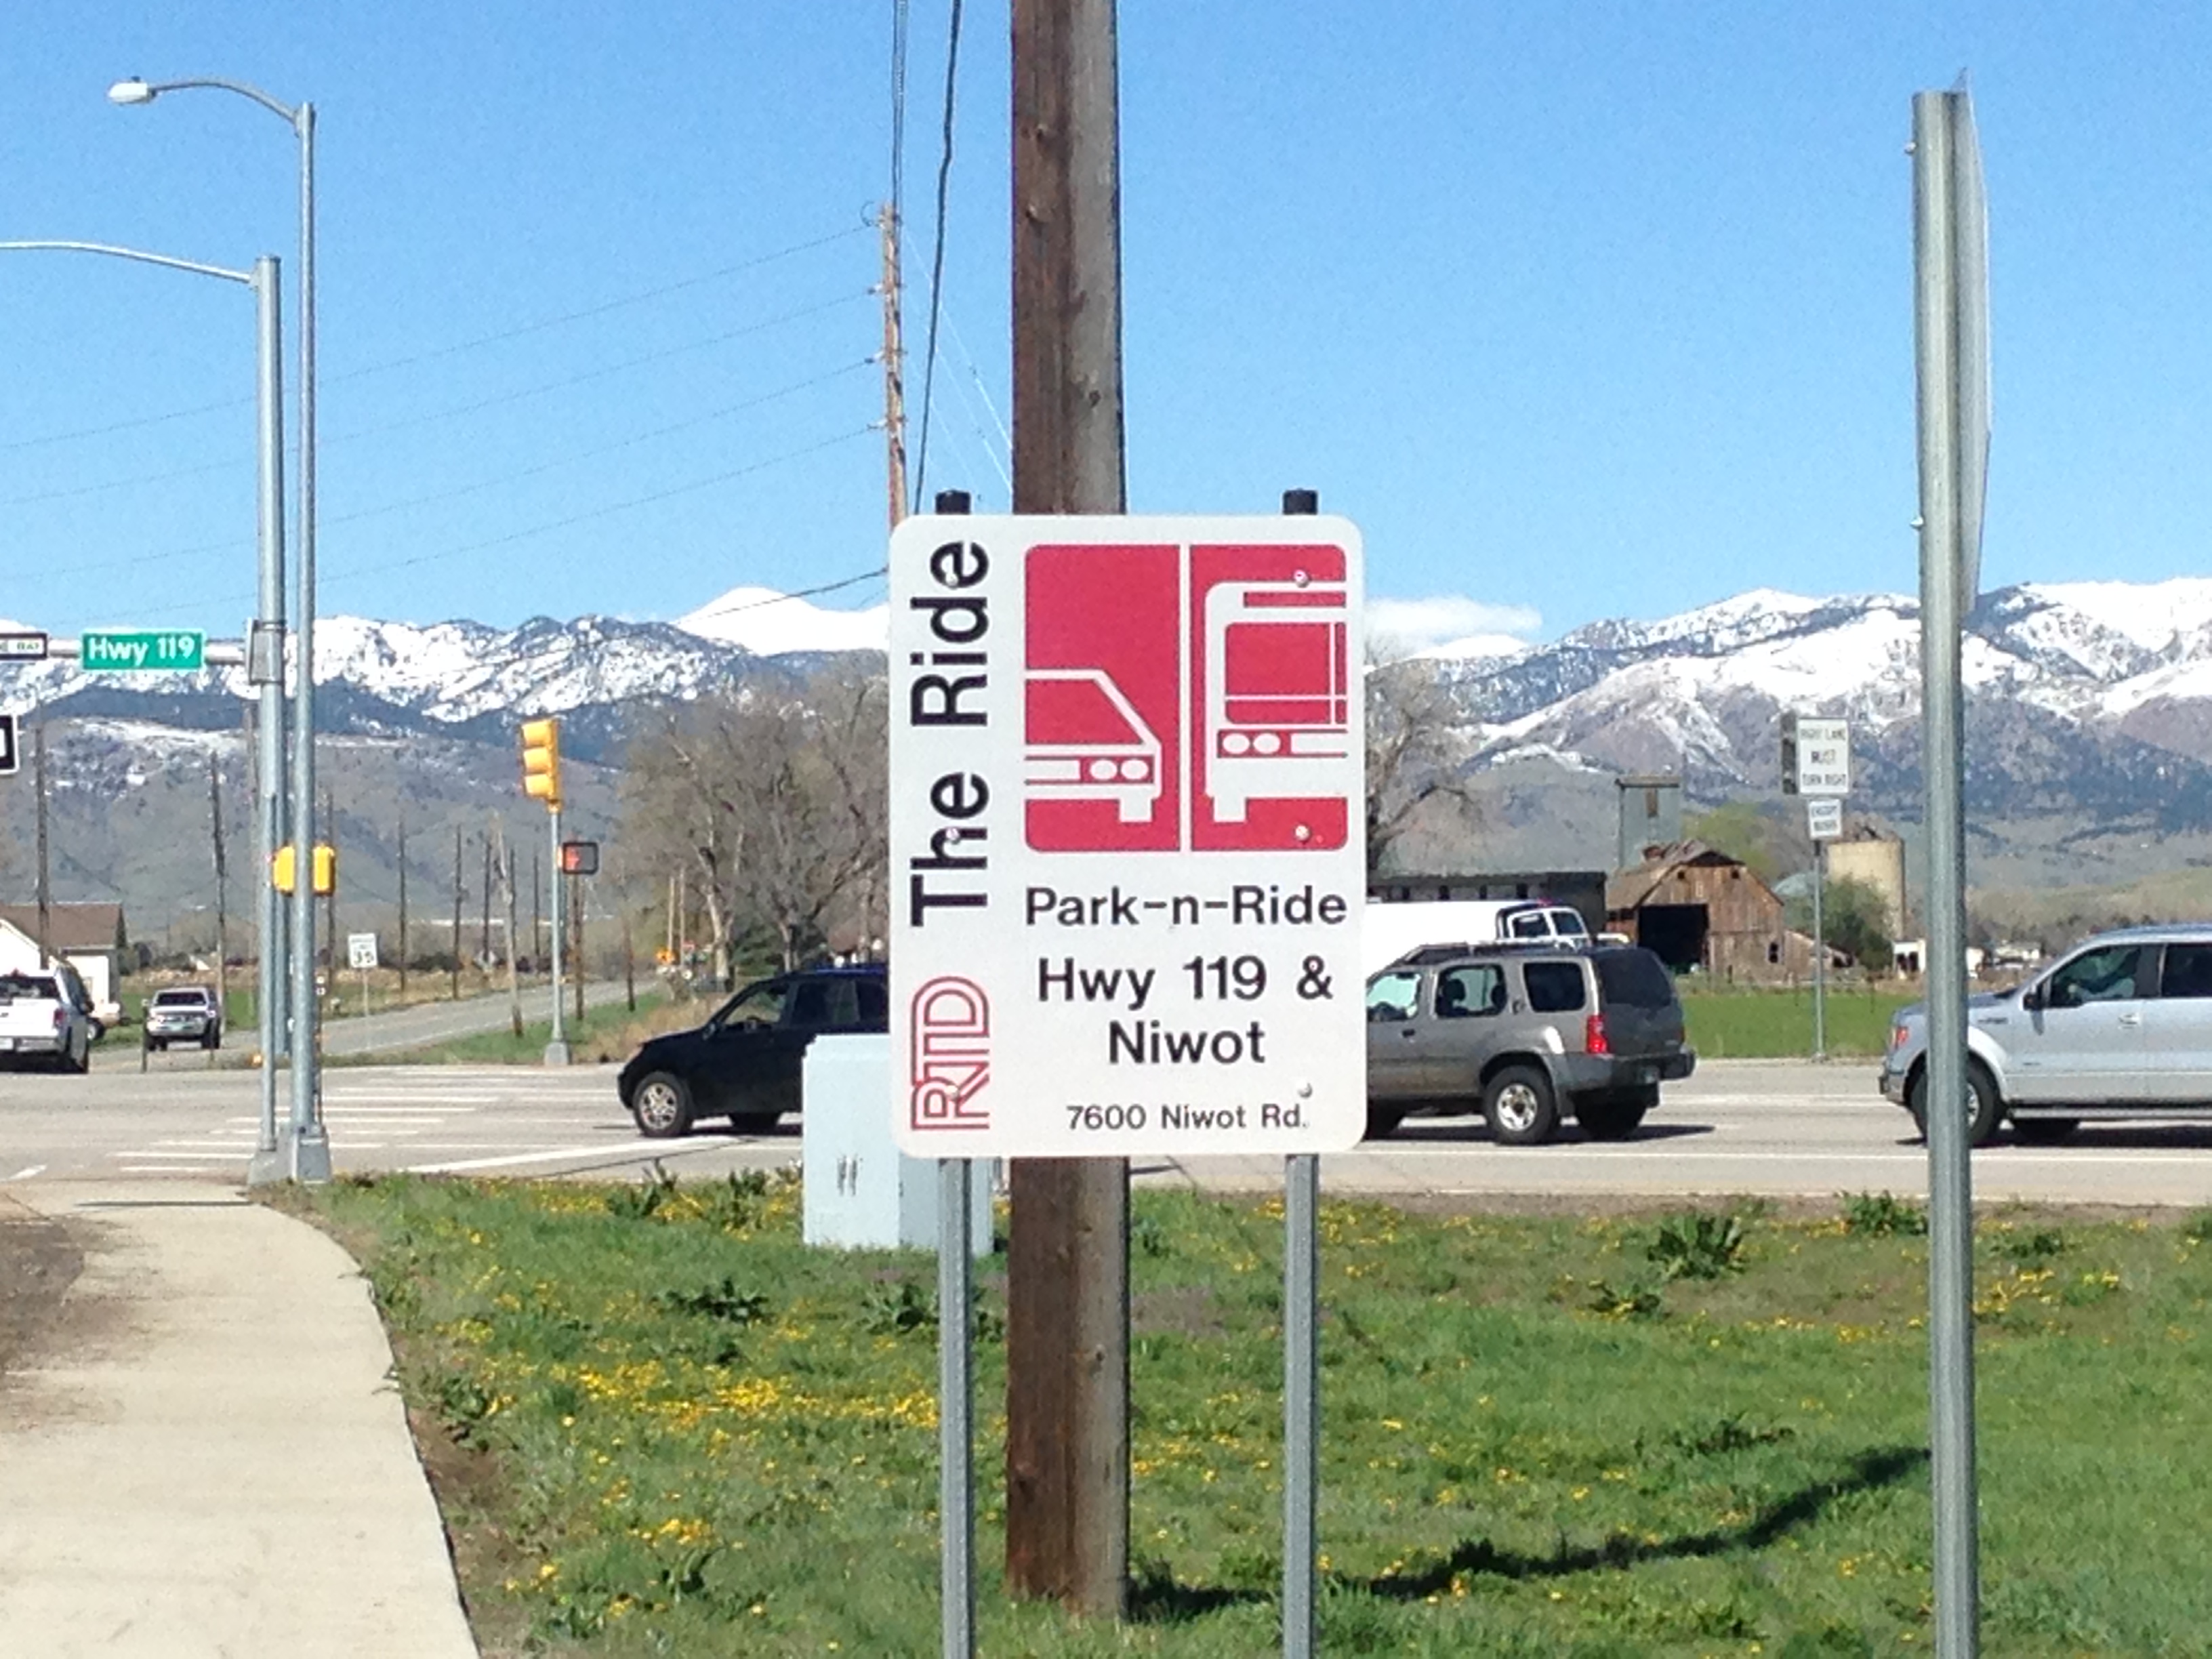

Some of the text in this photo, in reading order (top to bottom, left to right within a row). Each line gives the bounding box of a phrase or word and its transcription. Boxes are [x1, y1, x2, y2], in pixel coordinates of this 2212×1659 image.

[89, 636, 195, 666] Hwy 119
[910, 541, 990, 928] The Ride
[1026, 885, 1348, 927] Park-n-Ride
[1039, 956, 1334, 1012] Hwy 119 &
[910, 976, 991, 1132] RTD
[1109, 1021, 1266, 1065] Niwot
[1067, 1105, 1147, 1130] 7600
[1161, 1105, 1247, 1130] Niwot
